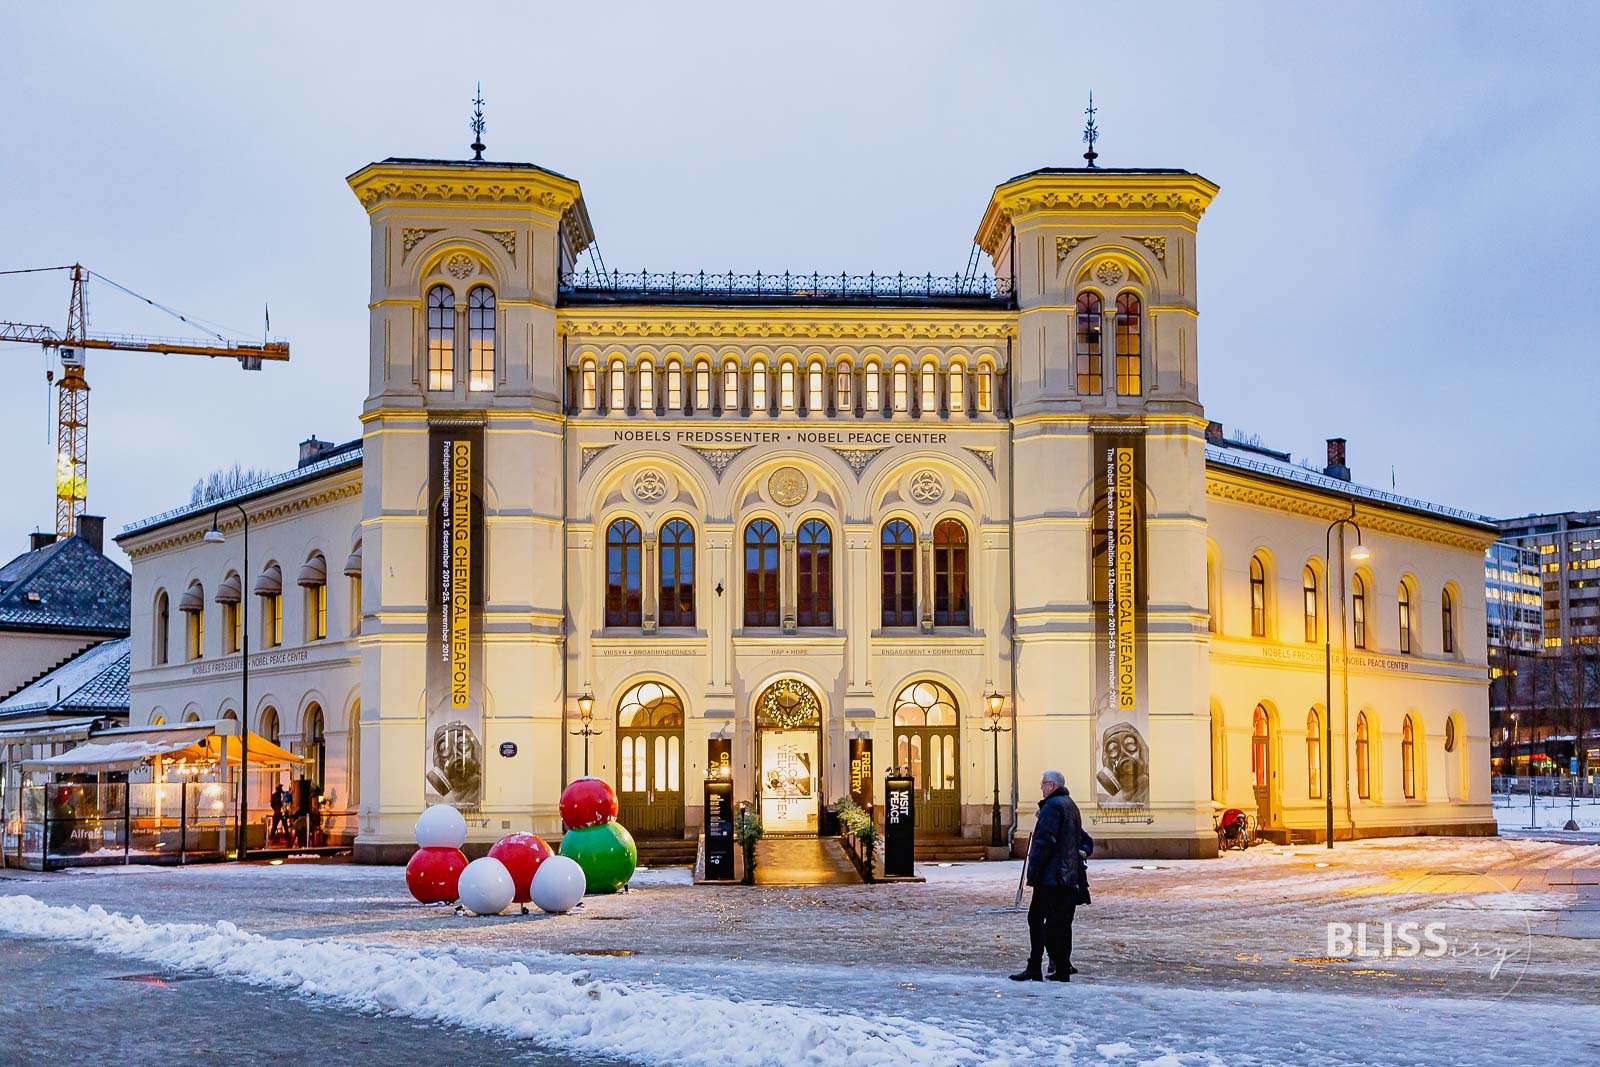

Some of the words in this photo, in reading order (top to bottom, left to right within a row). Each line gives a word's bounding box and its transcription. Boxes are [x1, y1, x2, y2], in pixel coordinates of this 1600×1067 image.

[613, 430, 671, 442] NOBELS
[676, 430, 780, 443] FREDSSENTER
[797, 432, 844, 443] NOBEL
[848, 433, 891, 443] PEACE
[895, 433, 947, 444] CENTER
[1107, 448, 1115, 462] The
[442, 440, 451, 517] Fredsprisutstillingen
[1107, 463, 1115, 486] Nobel
[455, 444, 469, 541] COMBATING
[1107, 487, 1115, 510] Peace
[1118, 452, 1132, 546] COMBATING
[1107, 510, 1116, 530] Prize
[443, 531, 451, 568] desember
[1108, 530, 1116, 567] exhibition
[454, 546, 468, 624] CHEMICAL
[1108, 568, 1115, 577] 12
[1119, 551, 1133, 627] CHEMICAL
[1108, 578, 1116, 617] December
[442, 604, 450, 642] november
[191, 664, 211, 675] NOBELS
[211, 660, 246, 673] FREDSSENTE
[251, 656, 269, 668] NOBEL
[269, 654, 286, 666] PEACE
[286, 651, 309, 663] CENTER
[442, 643, 450, 662] 2014
[453, 628, 467, 705] WEAPONS
[932, 648, 973, 656] COMMITMENT
[1120, 631, 1133, 707] WEAPONS
[1262, 647, 1291, 659] NOBELS
[1292, 650, 1340, 664] FREDSSEER
[1346, 656, 1366, 667] NOBEL
[1367, 658, 1386, 669] PEACE
[1386, 660, 1409, 671] CENTER
[1108, 651, 1116, 689] November
[788, 744, 798, 805] WELCME
[851, 759, 862, 794] ENTRY
[861, 751, 871, 779] FREE
[890, 791, 900, 824] PEACE
[899, 790, 909, 816] VISIT
